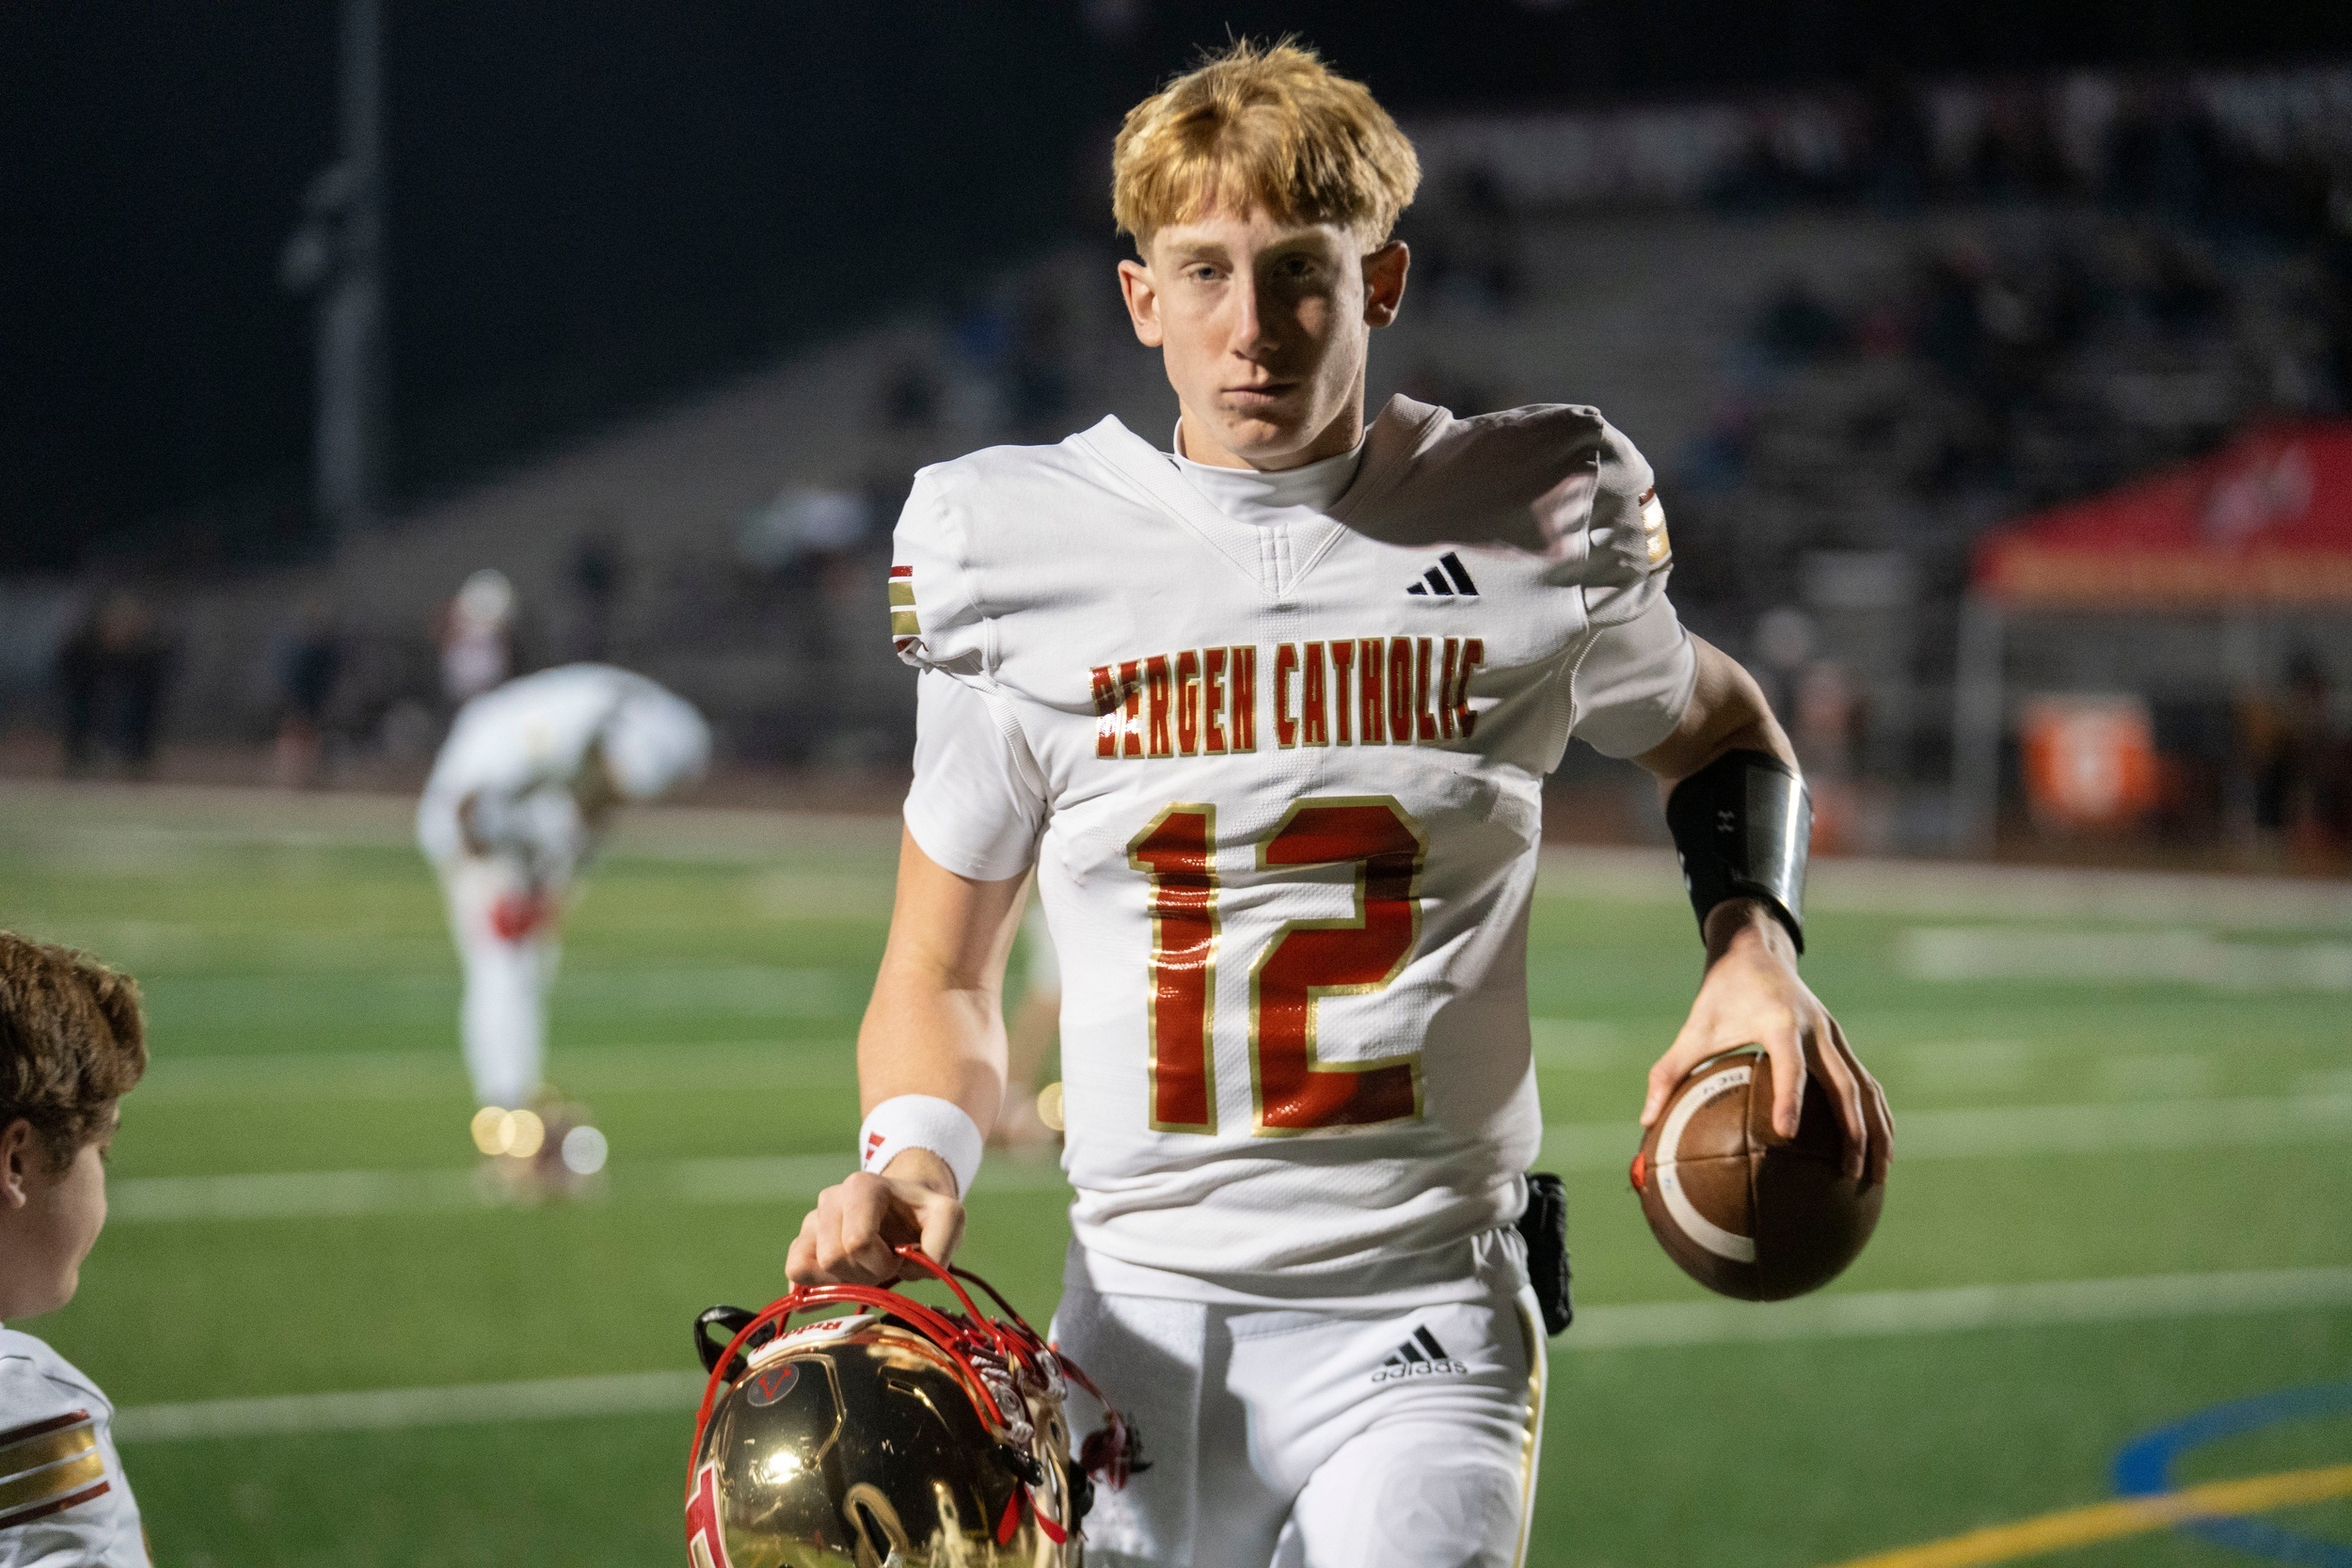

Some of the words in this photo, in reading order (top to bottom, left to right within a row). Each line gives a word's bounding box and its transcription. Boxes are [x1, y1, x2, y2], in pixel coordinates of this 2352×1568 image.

[1088, 644, 1257, 760] BERGEN
[1274, 635, 1485, 751] CATHOLIC
[1126, 794, 1431, 1139] 12
[1371, 1360, 1470, 1383] adidas
